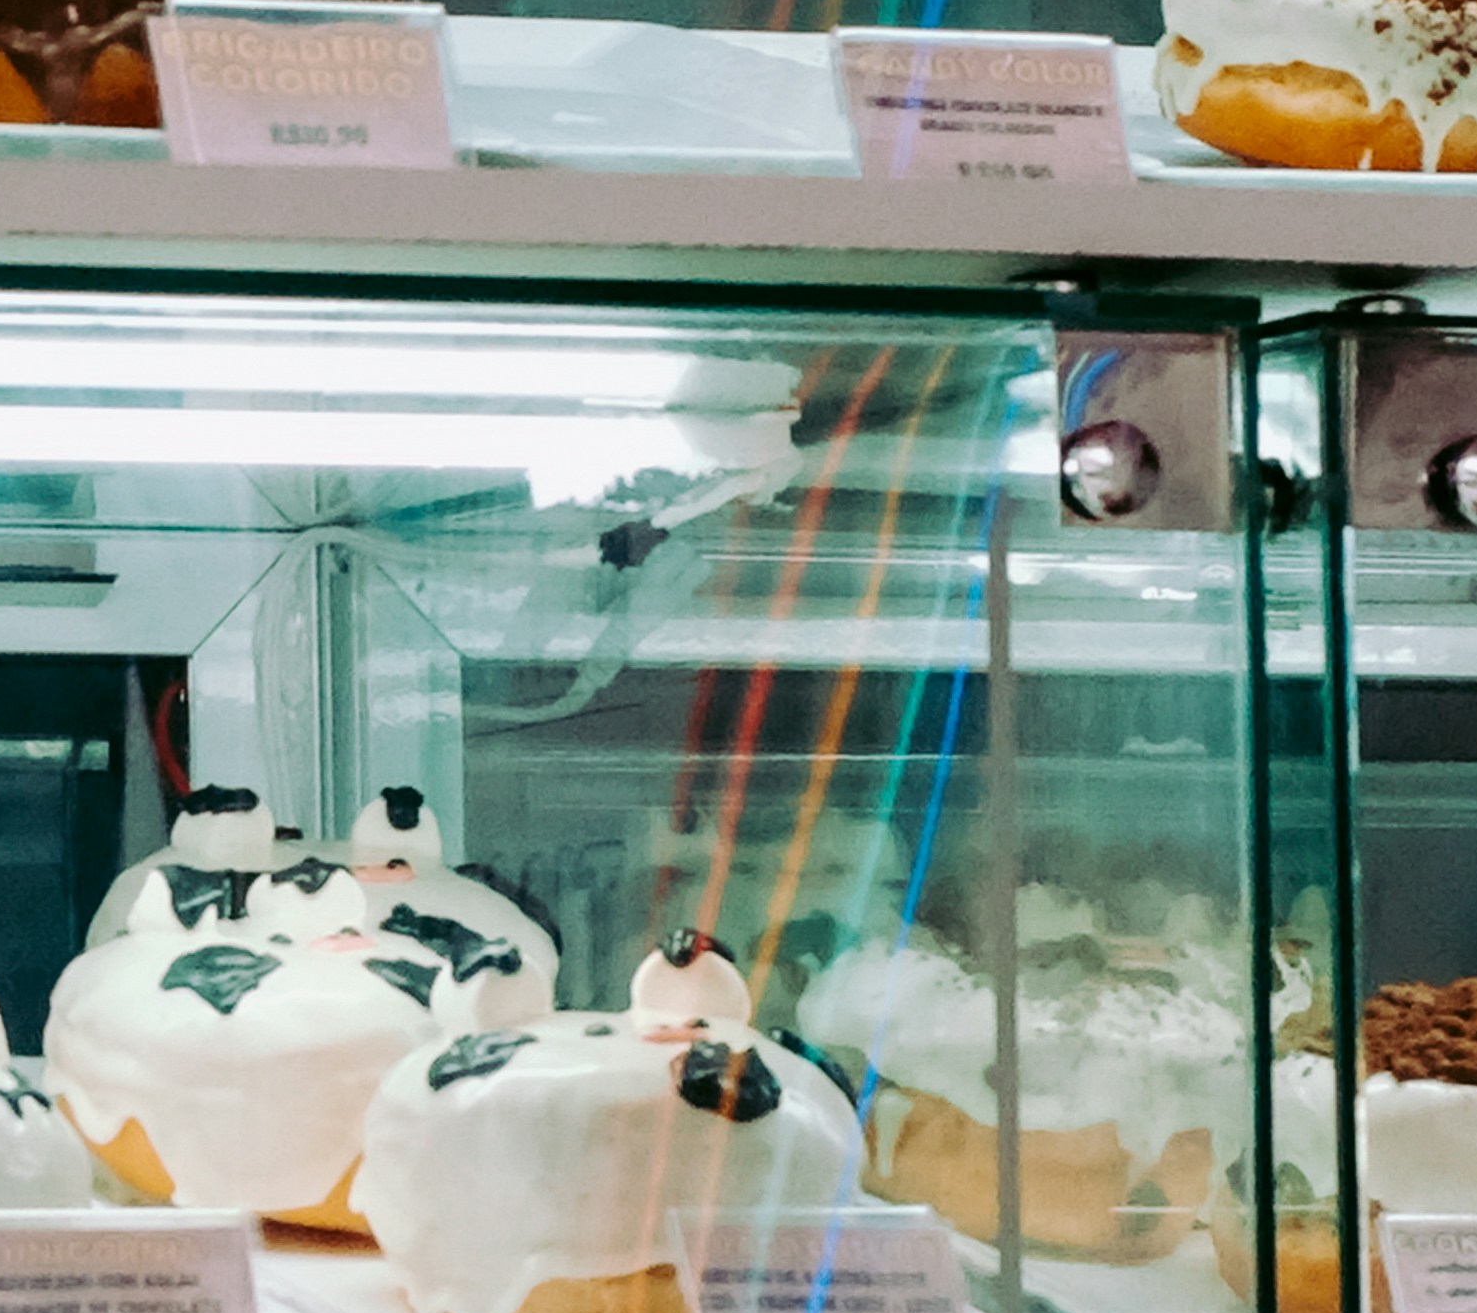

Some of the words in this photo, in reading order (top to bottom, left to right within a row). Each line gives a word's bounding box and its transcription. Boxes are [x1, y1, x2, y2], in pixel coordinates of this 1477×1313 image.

[161, 28, 428, 67] BRIGADEIRO
[189, 62, 415, 99] COLORIDO
[987, 56, 1105, 86] COLOR
